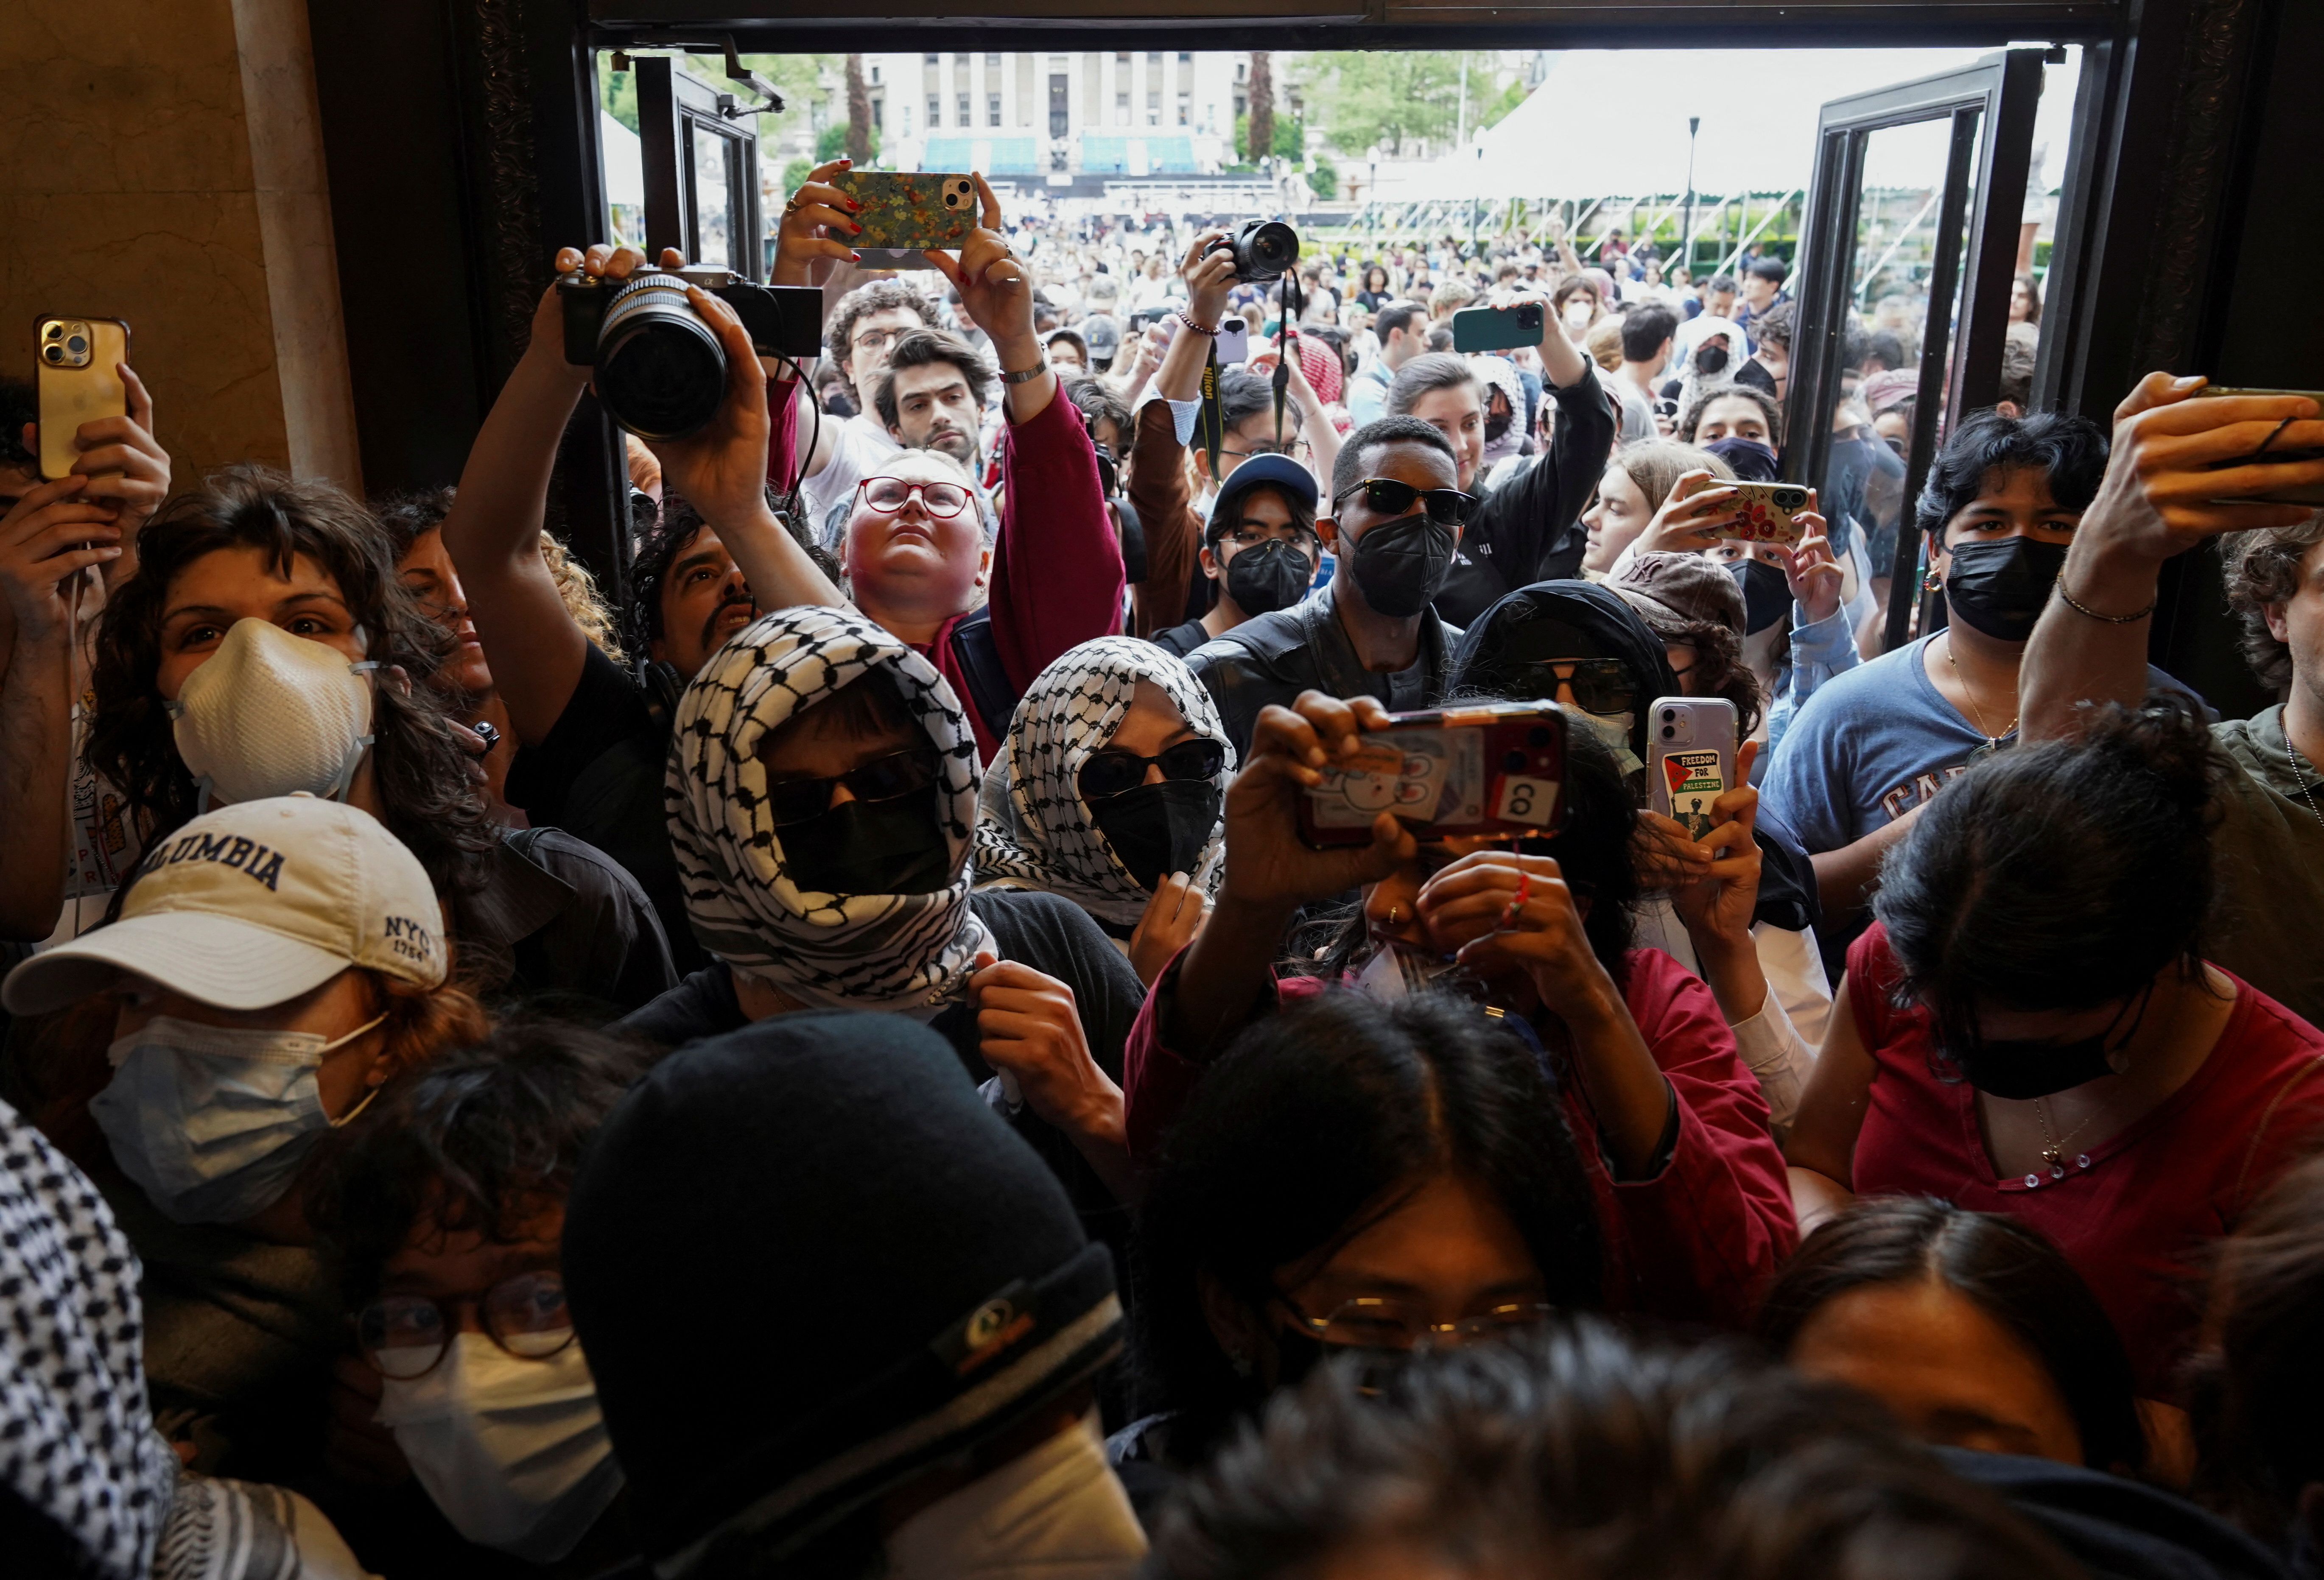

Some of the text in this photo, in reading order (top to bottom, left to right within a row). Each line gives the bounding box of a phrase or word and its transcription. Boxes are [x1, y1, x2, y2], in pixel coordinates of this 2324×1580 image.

[1204, 366, 1213, 399] Nikon
[1681, 754, 1716, 766] FREEDOM
[1695, 768, 1709, 777] FOR
[1683, 781, 1720, 790] PALESTINE
[140, 833, 286, 892] OLUMBIA
[385, 916, 430, 955] NYC
[394, 939, 422, 963] 1754
